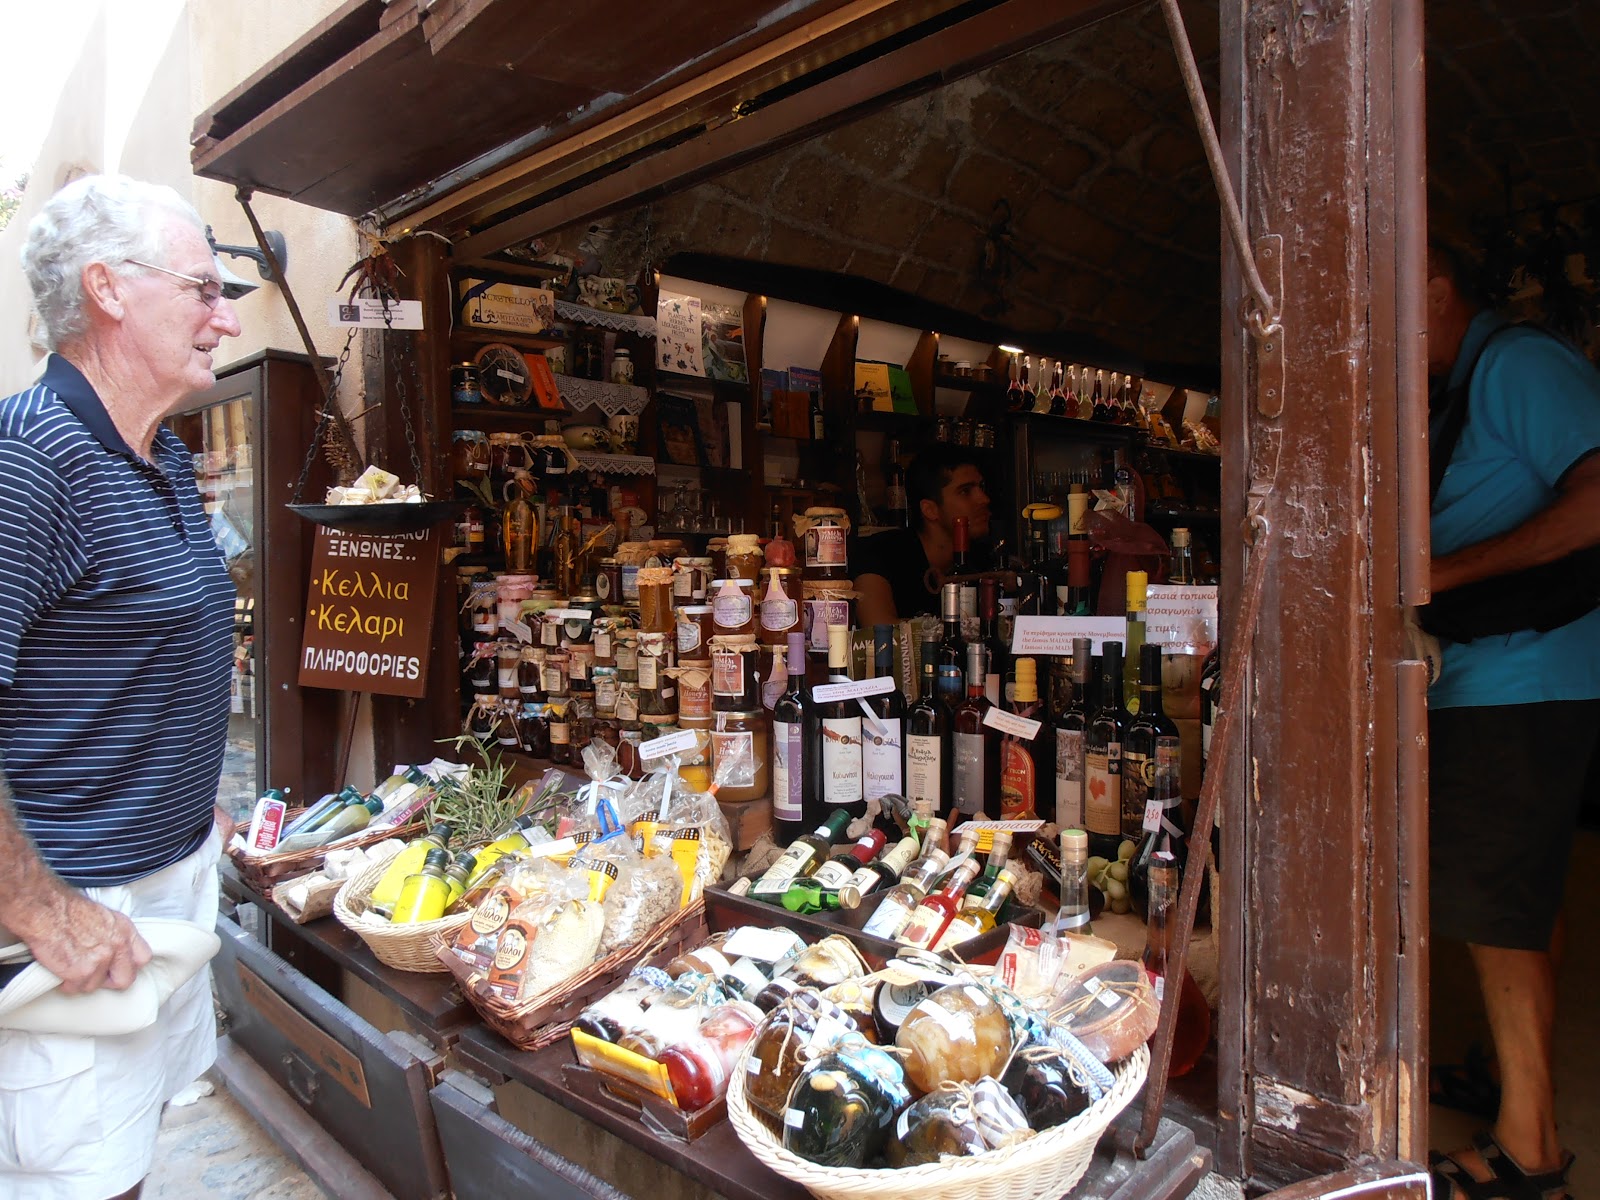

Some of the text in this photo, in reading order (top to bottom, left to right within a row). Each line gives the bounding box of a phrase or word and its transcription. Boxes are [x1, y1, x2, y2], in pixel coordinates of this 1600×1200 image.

[321, 568, 409, 601] Κελλια
[317, 603, 404, 643] Κελαρι
[683, 690, 703, 698] Honey
[1145, 808, 1160, 823] 2,50
